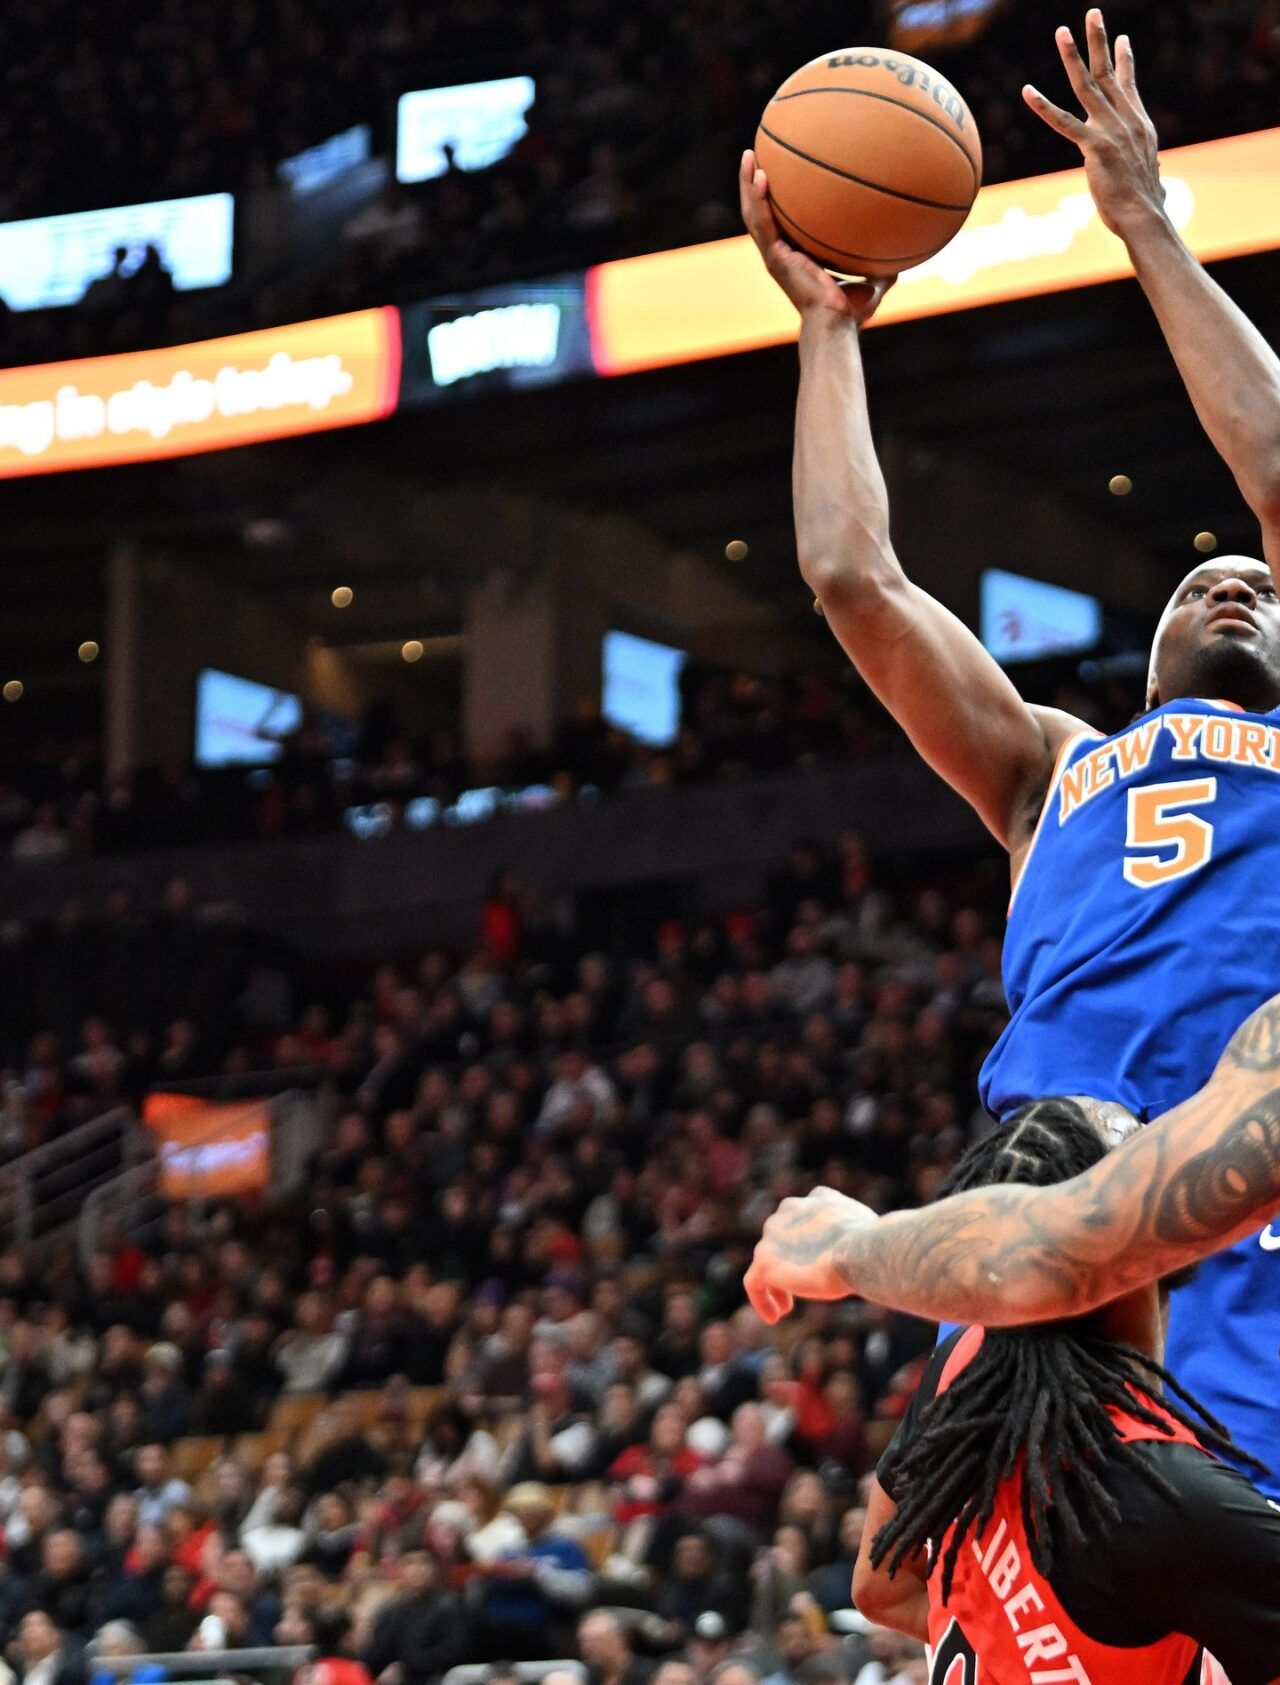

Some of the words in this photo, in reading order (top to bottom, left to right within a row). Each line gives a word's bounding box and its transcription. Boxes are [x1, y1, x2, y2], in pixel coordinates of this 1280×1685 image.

[827, 54, 966, 131] Wilson
[1059, 715, 1163, 827] NEW
[1123, 777, 1217, 888] 5
